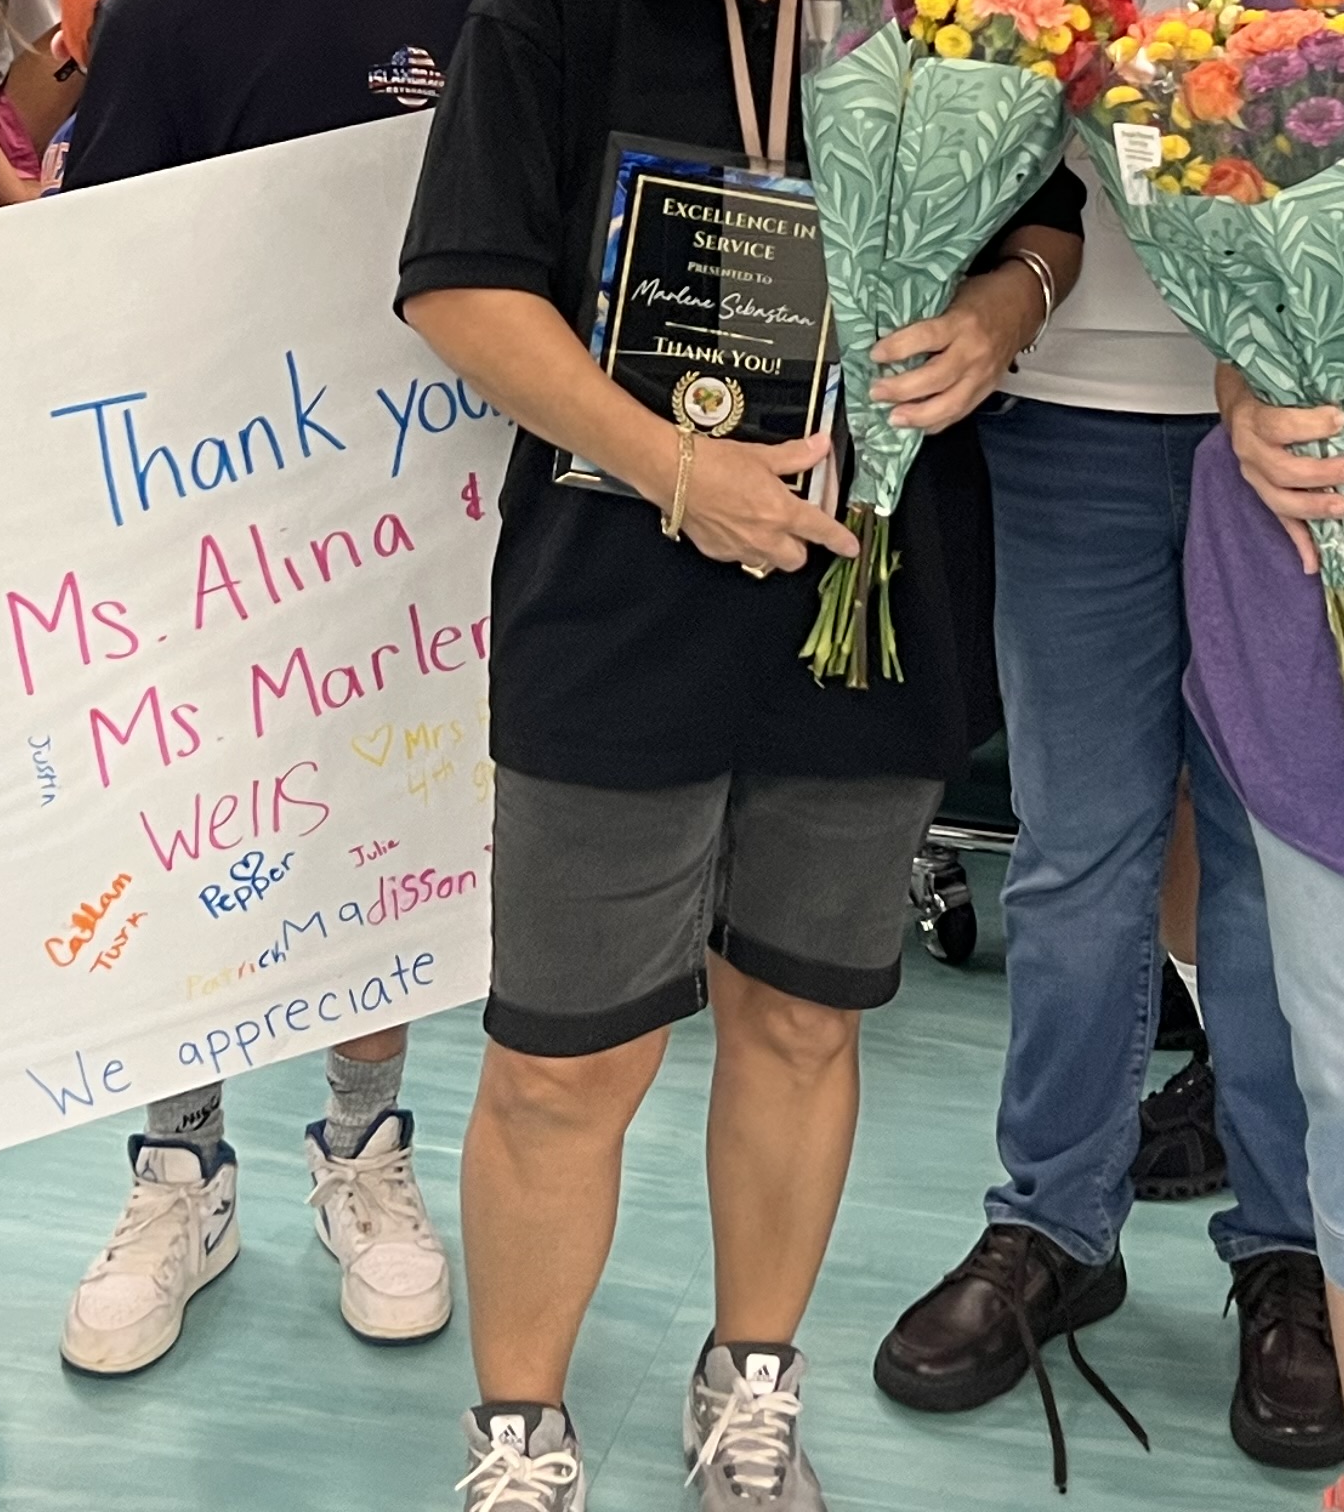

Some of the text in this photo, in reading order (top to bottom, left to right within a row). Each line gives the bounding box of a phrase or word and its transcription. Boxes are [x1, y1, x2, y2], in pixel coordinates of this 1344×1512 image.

[662, 197, 817, 240] EXCELLENCE IN
[693, 230, 776, 261] SERVICE
[687, 261, 753, 284] PRESENTED
[630, 278, 816, 328] Marlene Sebastian
[654, 335, 783, 376] THANK YOU!
[50, 350, 346, 527] Thank
[6, 570, 168, 696] Ms.
[194, 513, 415, 630] Alina
[90, 685, 225, 789] Ms.
[27, 735, 60, 808] Justin
[347, 839, 401, 869] Julie
[197, 850, 296, 920] Pepper
[25, 1050, 132, 1115] We
[178, 950, 435, 1074] appreciate
